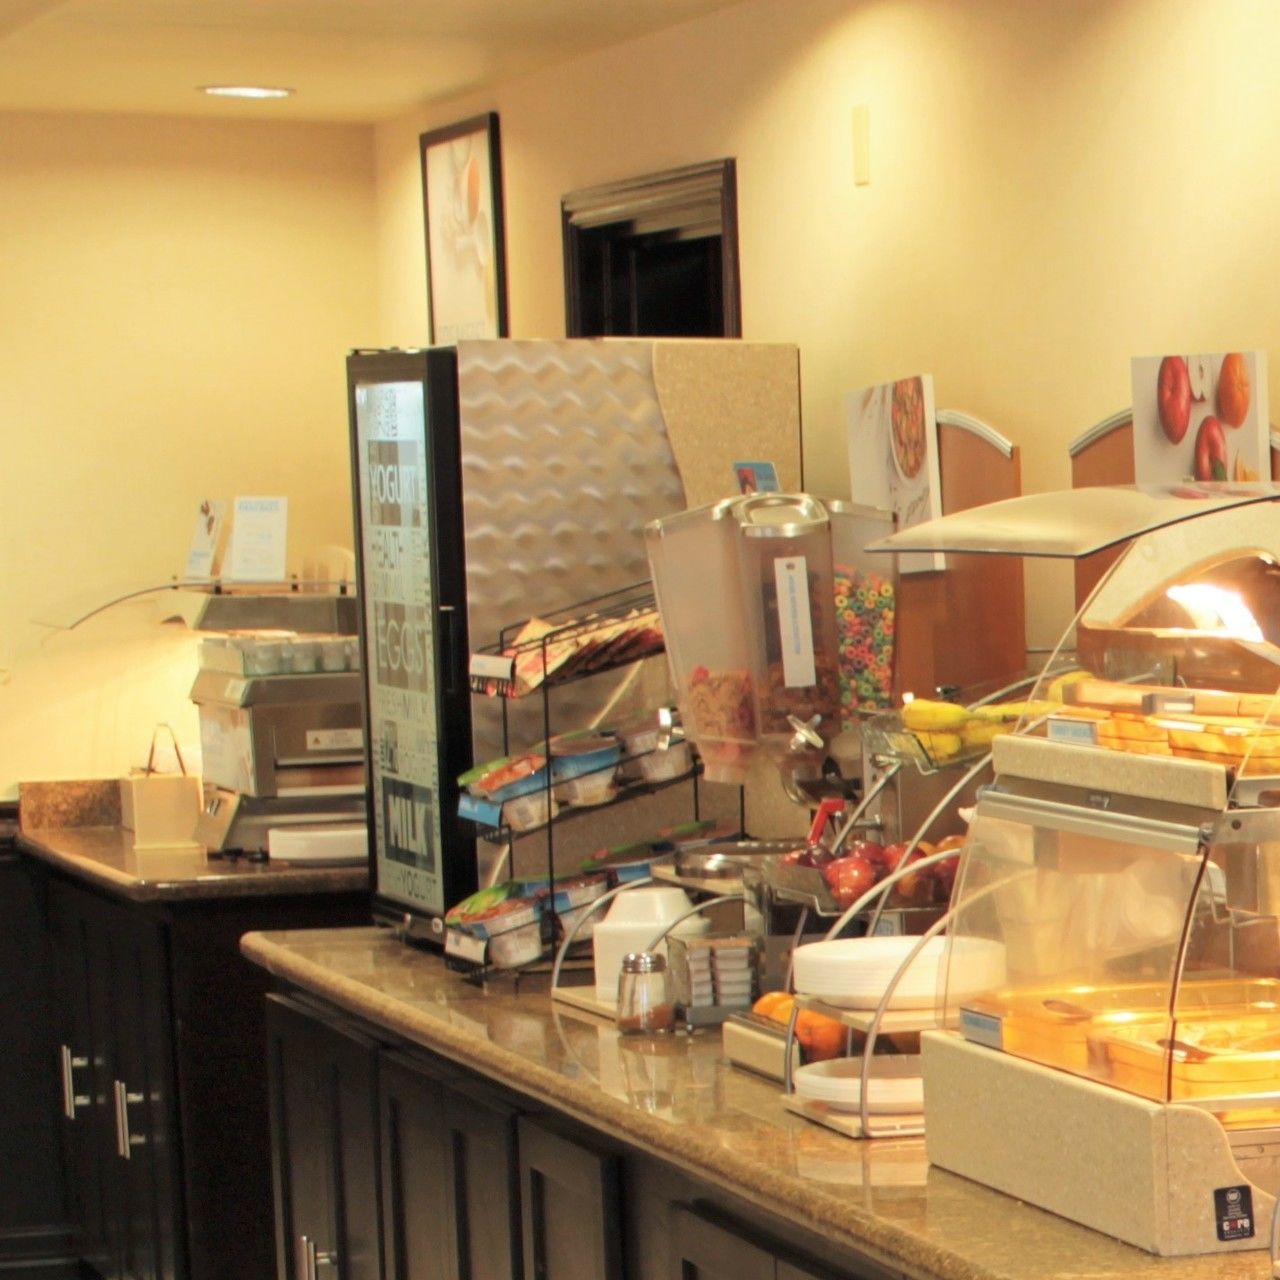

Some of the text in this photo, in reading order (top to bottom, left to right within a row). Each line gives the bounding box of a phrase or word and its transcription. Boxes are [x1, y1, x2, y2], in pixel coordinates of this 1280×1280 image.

[369, 463, 419, 506] YOGURT
[388, 794, 430, 858] MILK
[401, 867, 436, 906] YOGURT
